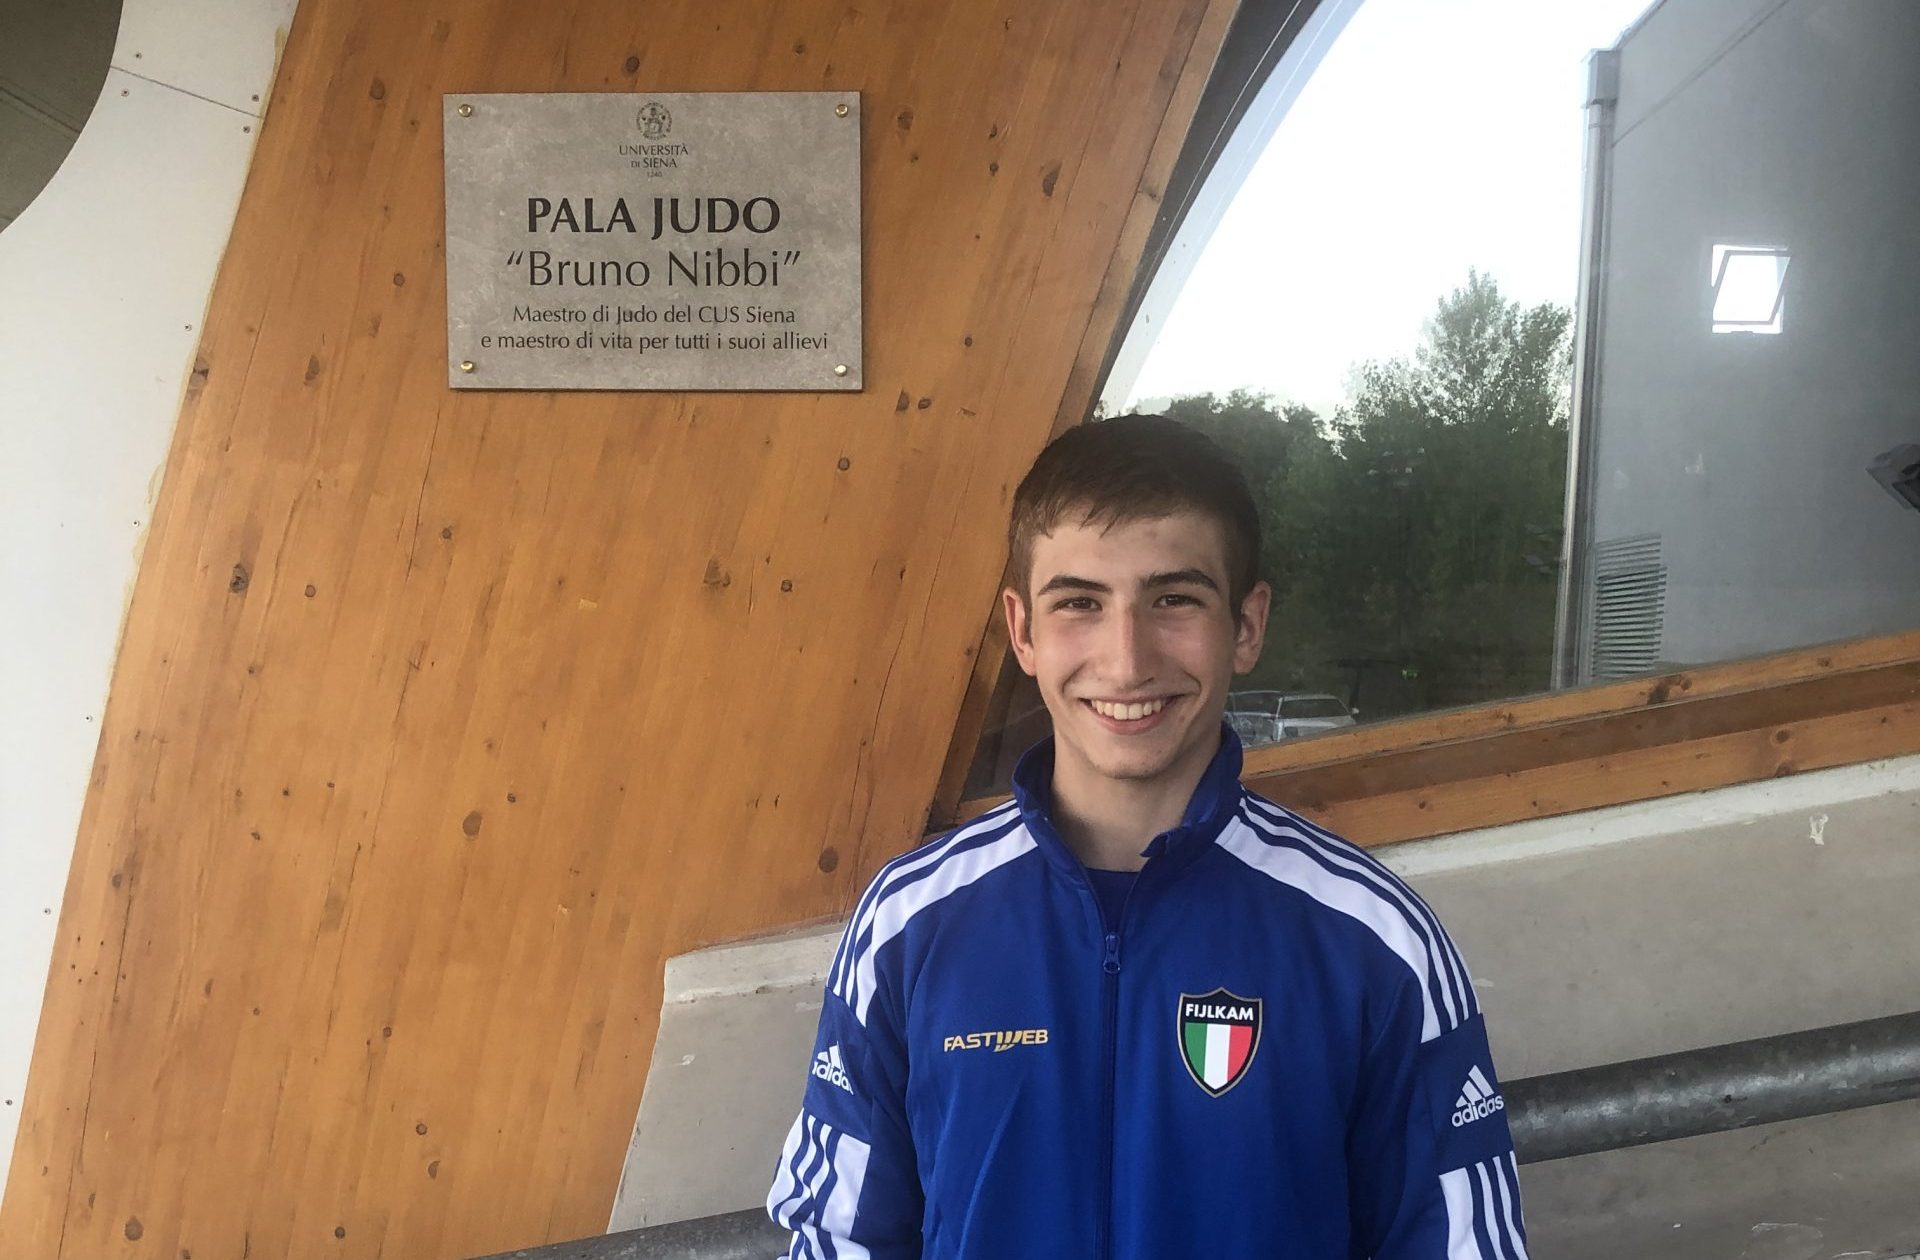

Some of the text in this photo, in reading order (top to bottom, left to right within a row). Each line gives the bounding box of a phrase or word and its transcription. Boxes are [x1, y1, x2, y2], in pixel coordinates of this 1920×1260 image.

[619, 142, 689, 156] UNIVERSITÀ
[631, 157, 678, 168] DI SIENA
[528, 196, 780, 240] PALA JUDO
[506, 247, 801, 287] “Bruno Nibbi”
[512, 304, 796, 325] Maestro di Judo del CUS Siena
[480, 330, 828, 354] e maestro di vita per tutti i suoi allievi
[1185, 1003, 1254, 1021] FIJLKAM
[943, 1029, 1049, 1052] FASTWEB
[1451, 1095, 1504, 1127] adidas
